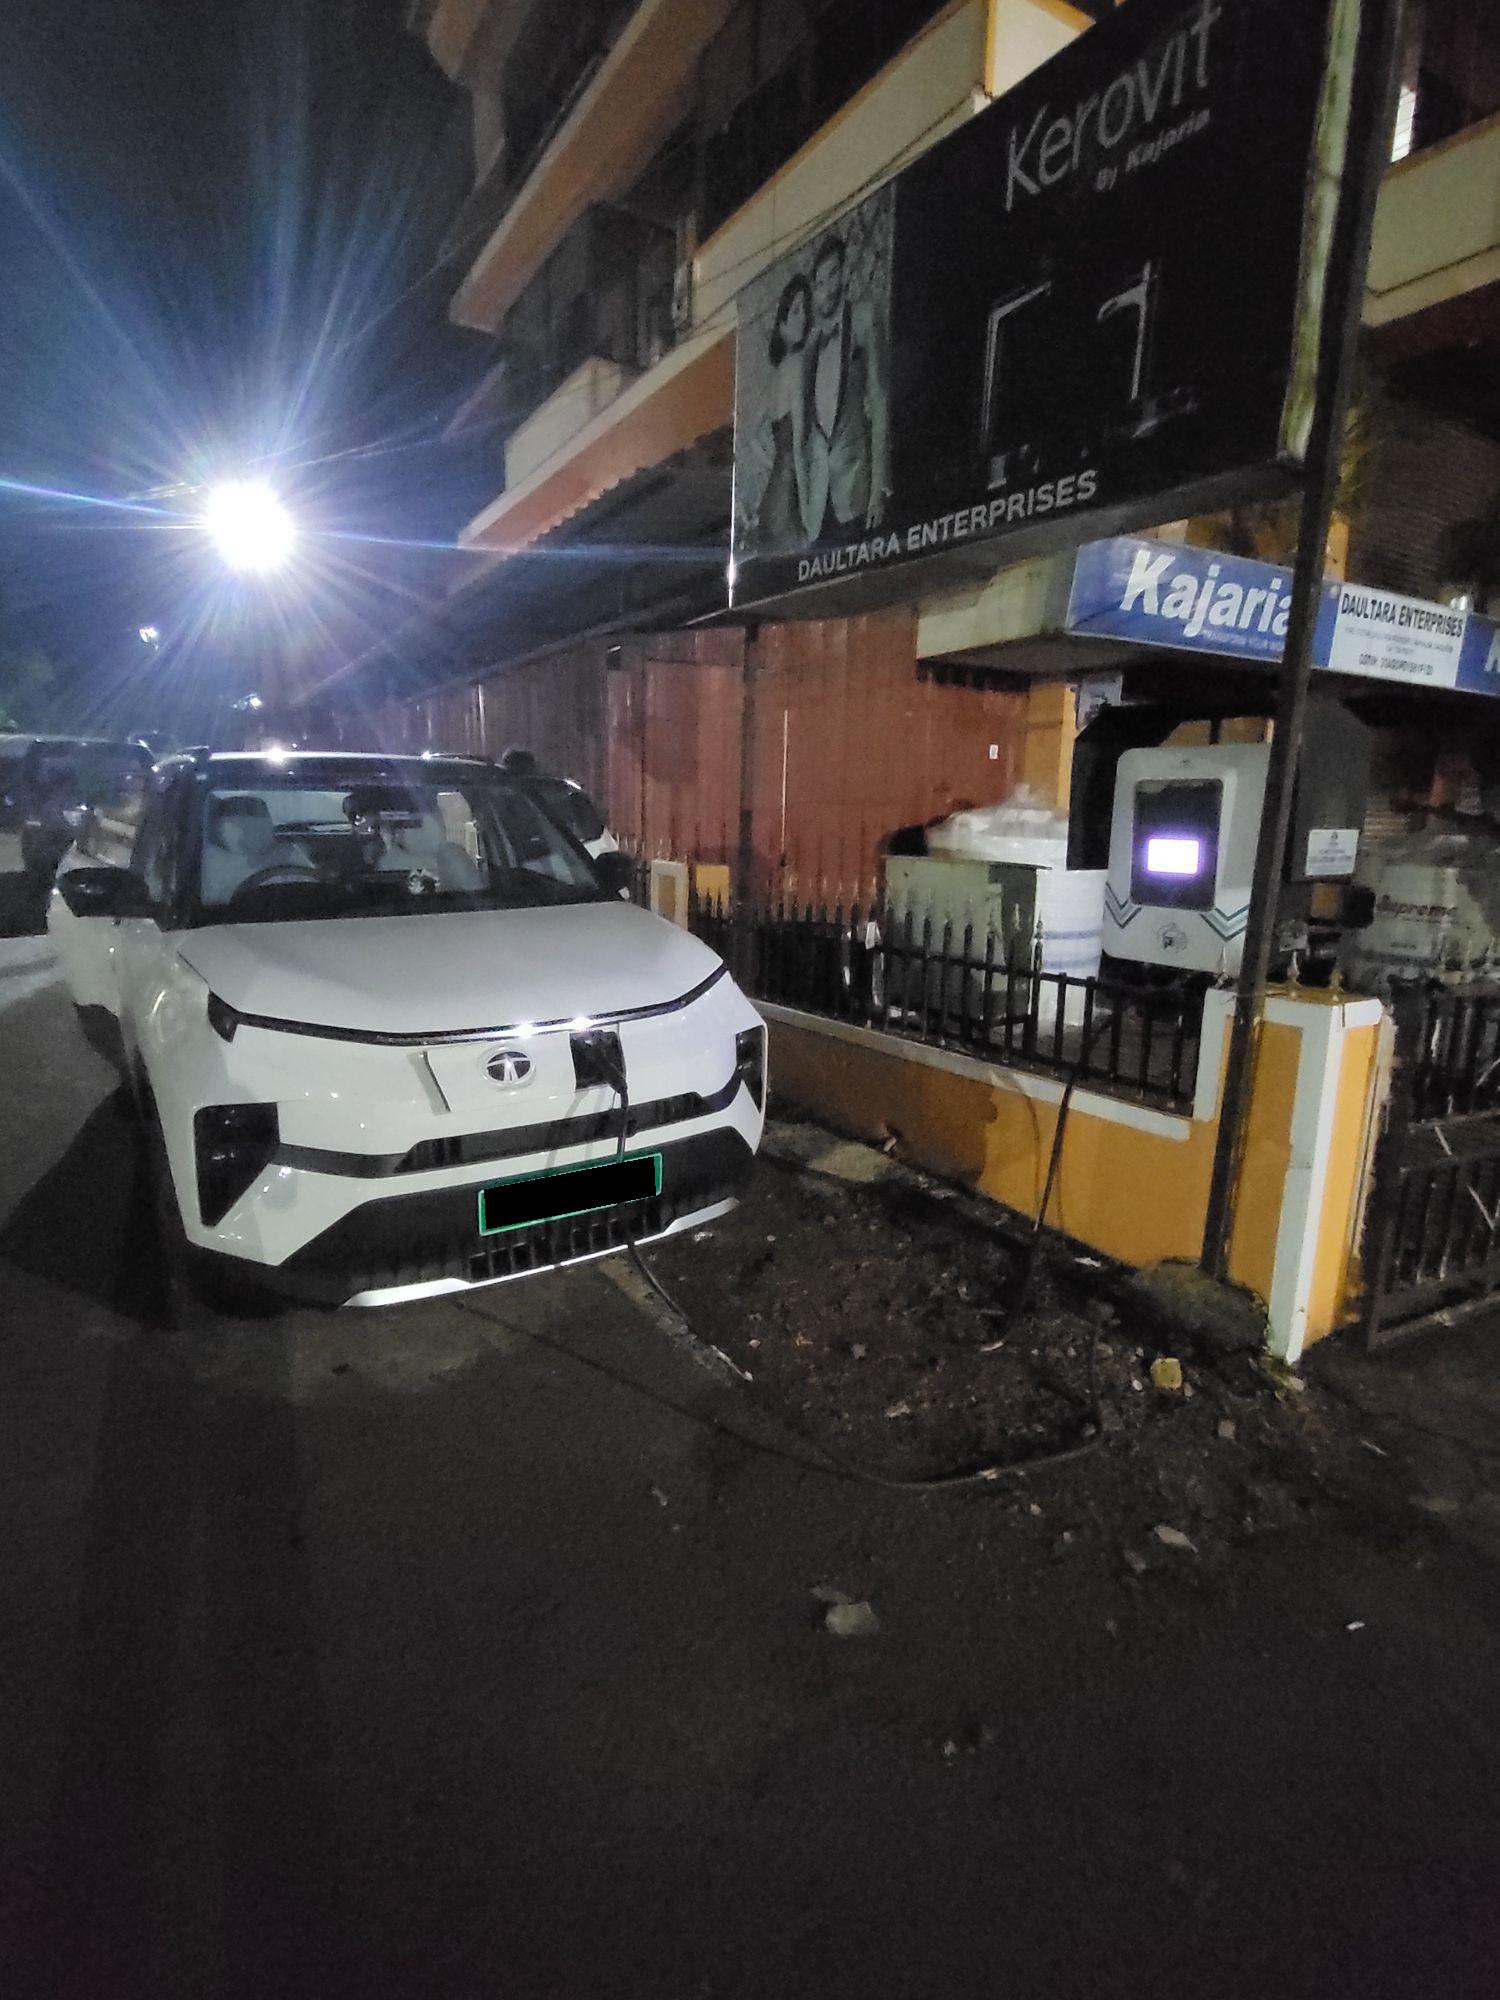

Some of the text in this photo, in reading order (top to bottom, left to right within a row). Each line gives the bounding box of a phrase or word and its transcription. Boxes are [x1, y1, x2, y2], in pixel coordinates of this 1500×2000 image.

[797, 469, 1098, 582] DAULTARA ENTERPRISES
[1119, 549, 1293, 638] Kajaria
[1340, 592, 1464, 638] DAULTARA ENTERPRISES
